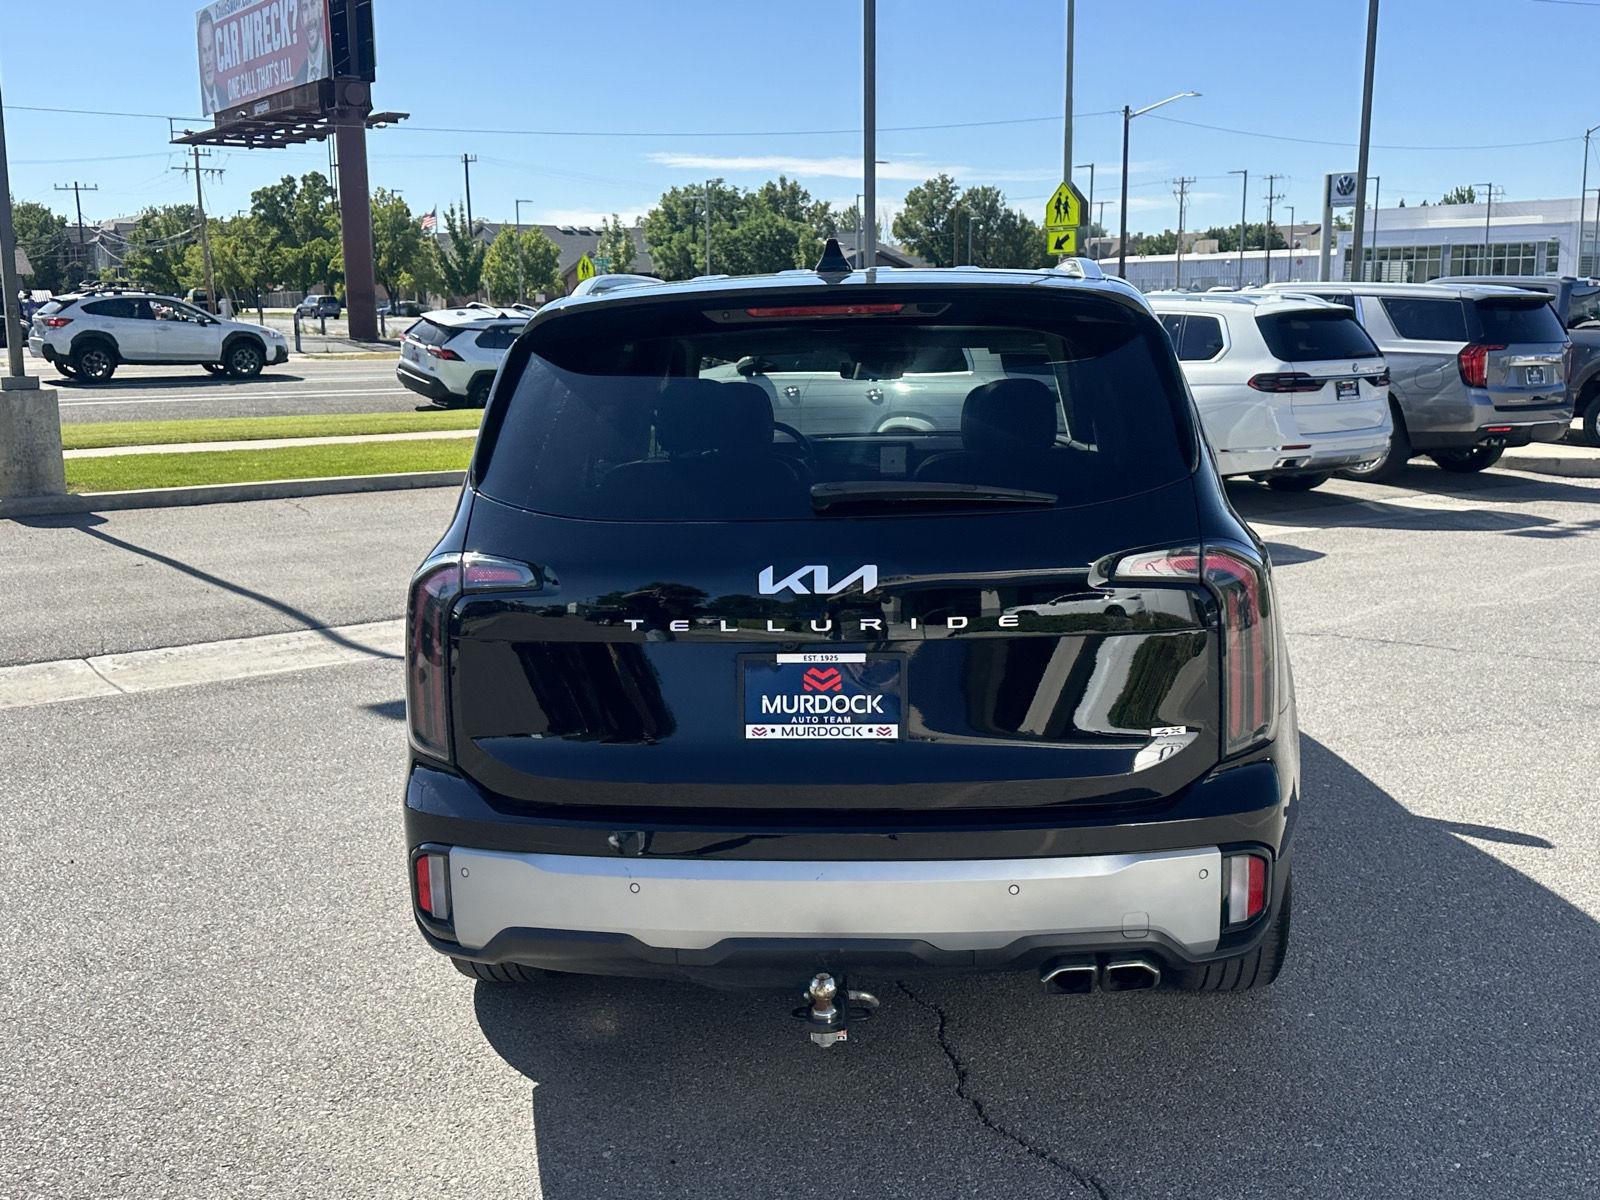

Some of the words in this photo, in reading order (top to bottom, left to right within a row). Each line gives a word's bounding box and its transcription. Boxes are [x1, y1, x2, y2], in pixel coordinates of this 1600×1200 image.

[215, 21, 240, 73] CAR
[240, 0, 298, 62] WRECK?
[227, 76, 241, 101] ONE
[241, 70, 257, 97] CALL
[257, 60, 280, 92] THAT'S
[281, 57, 294, 84] ALL
[758, 564, 878, 595] KIA
[624, 615, 1020, 633] TELLURIDE
[803, 654, 818, 662] EST.
[820, 654, 839, 662] 1925
[761, 694, 885, 714] MURDOCK
[791, 716, 819, 724] AUTO
[824, 716, 851, 724] TEAM
[781, 726, 863, 737] MURDOCK
